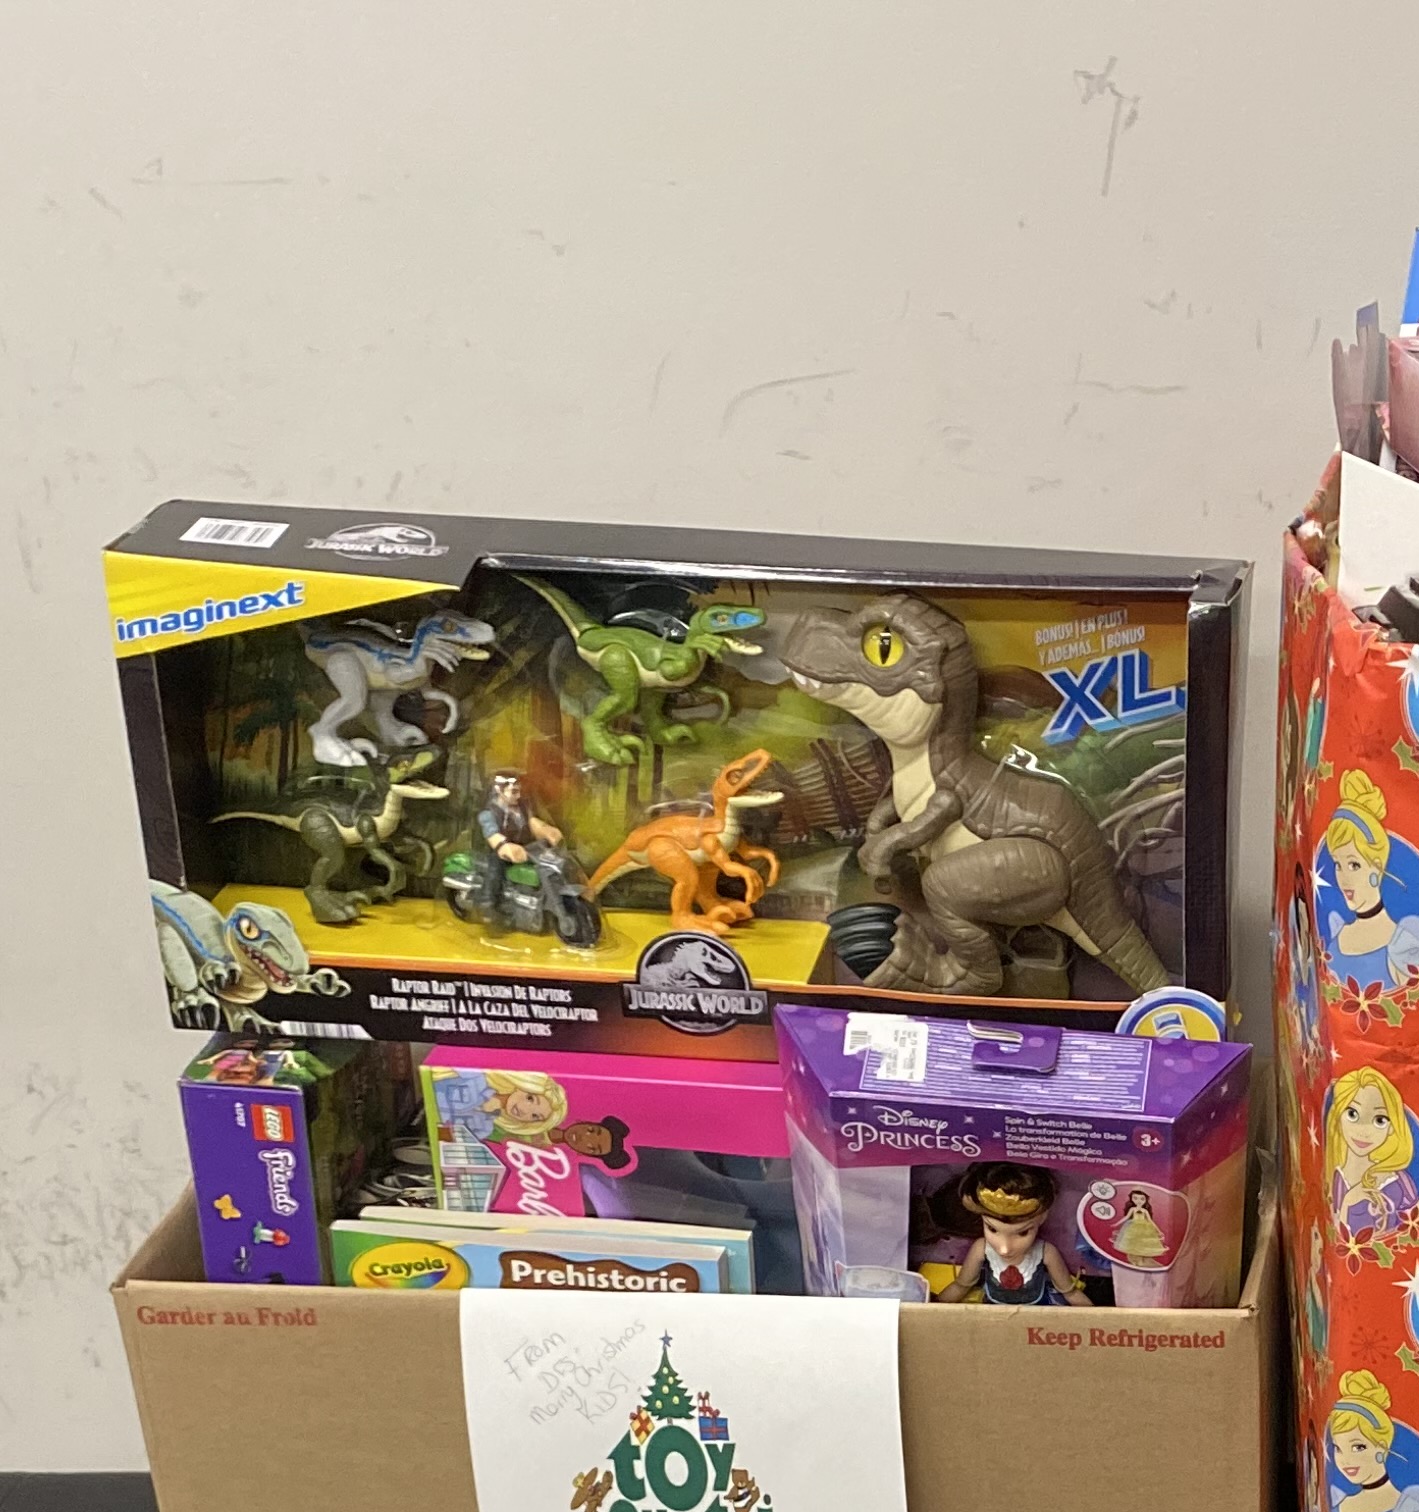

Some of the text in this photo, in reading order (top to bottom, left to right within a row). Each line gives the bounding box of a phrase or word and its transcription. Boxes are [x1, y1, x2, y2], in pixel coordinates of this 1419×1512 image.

[116, 581, 305, 642] imaginext
[1041, 648, 1185, 745] XL
[628, 989, 765, 1016] JURASSIC WORLD
[261, 1106, 284, 1143] LEGO
[840, 1121, 982, 1158] PRINCESS
[1140, 1133, 1162, 1148] 3+
[504, 1140, 571, 1217] Barb
[367, 1256, 446, 1279] Crayola
[510, 1258, 689, 1294] Prehistoric
[136, 1305, 318, 1328] Garder au Froid
[1026, 1327, 1226, 1352] Keep Refrigerated
